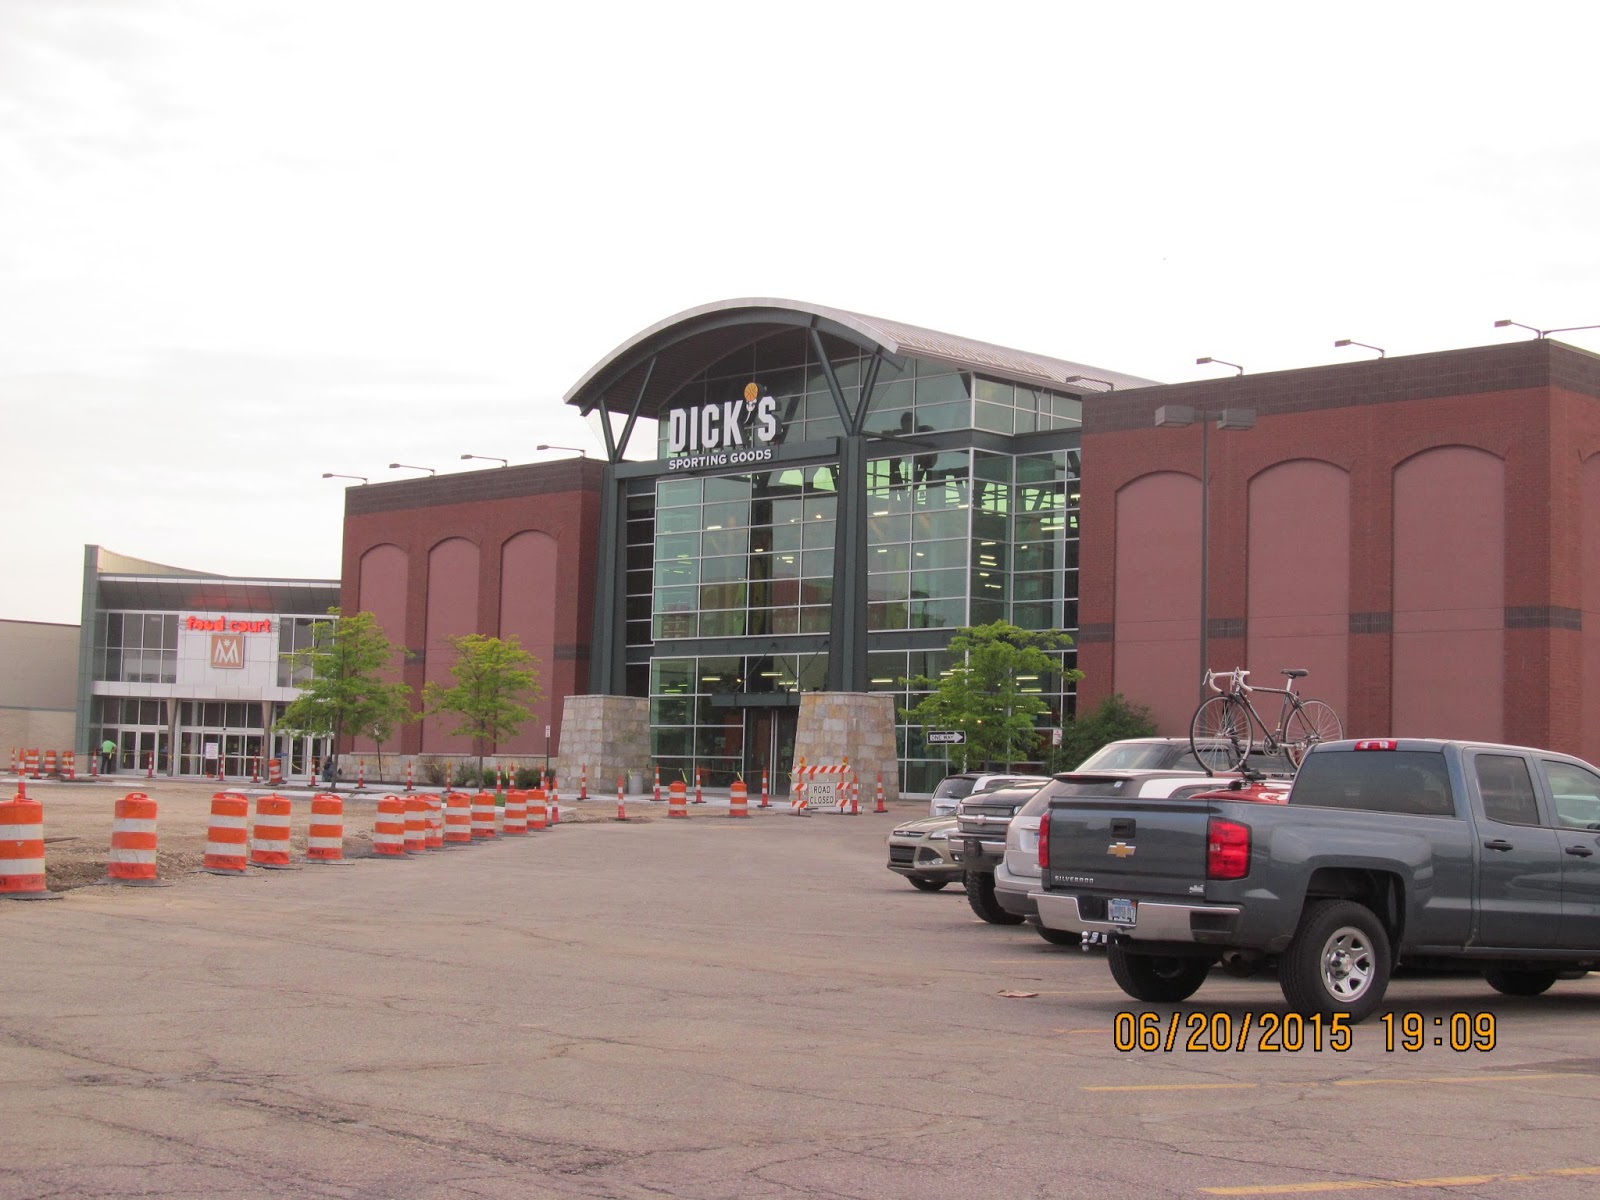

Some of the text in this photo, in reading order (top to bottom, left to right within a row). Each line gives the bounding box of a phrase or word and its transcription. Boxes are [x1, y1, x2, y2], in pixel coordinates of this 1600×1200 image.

[669, 396, 776, 453] DICK'S
[668, 449, 772, 470] SPORTING GOODS
[187, 615, 271, 633] food court
[813, 785, 831, 794] ROAD
[809, 795, 834, 805] CLOSED
[1054, 875, 1094, 884] SILVERADO
